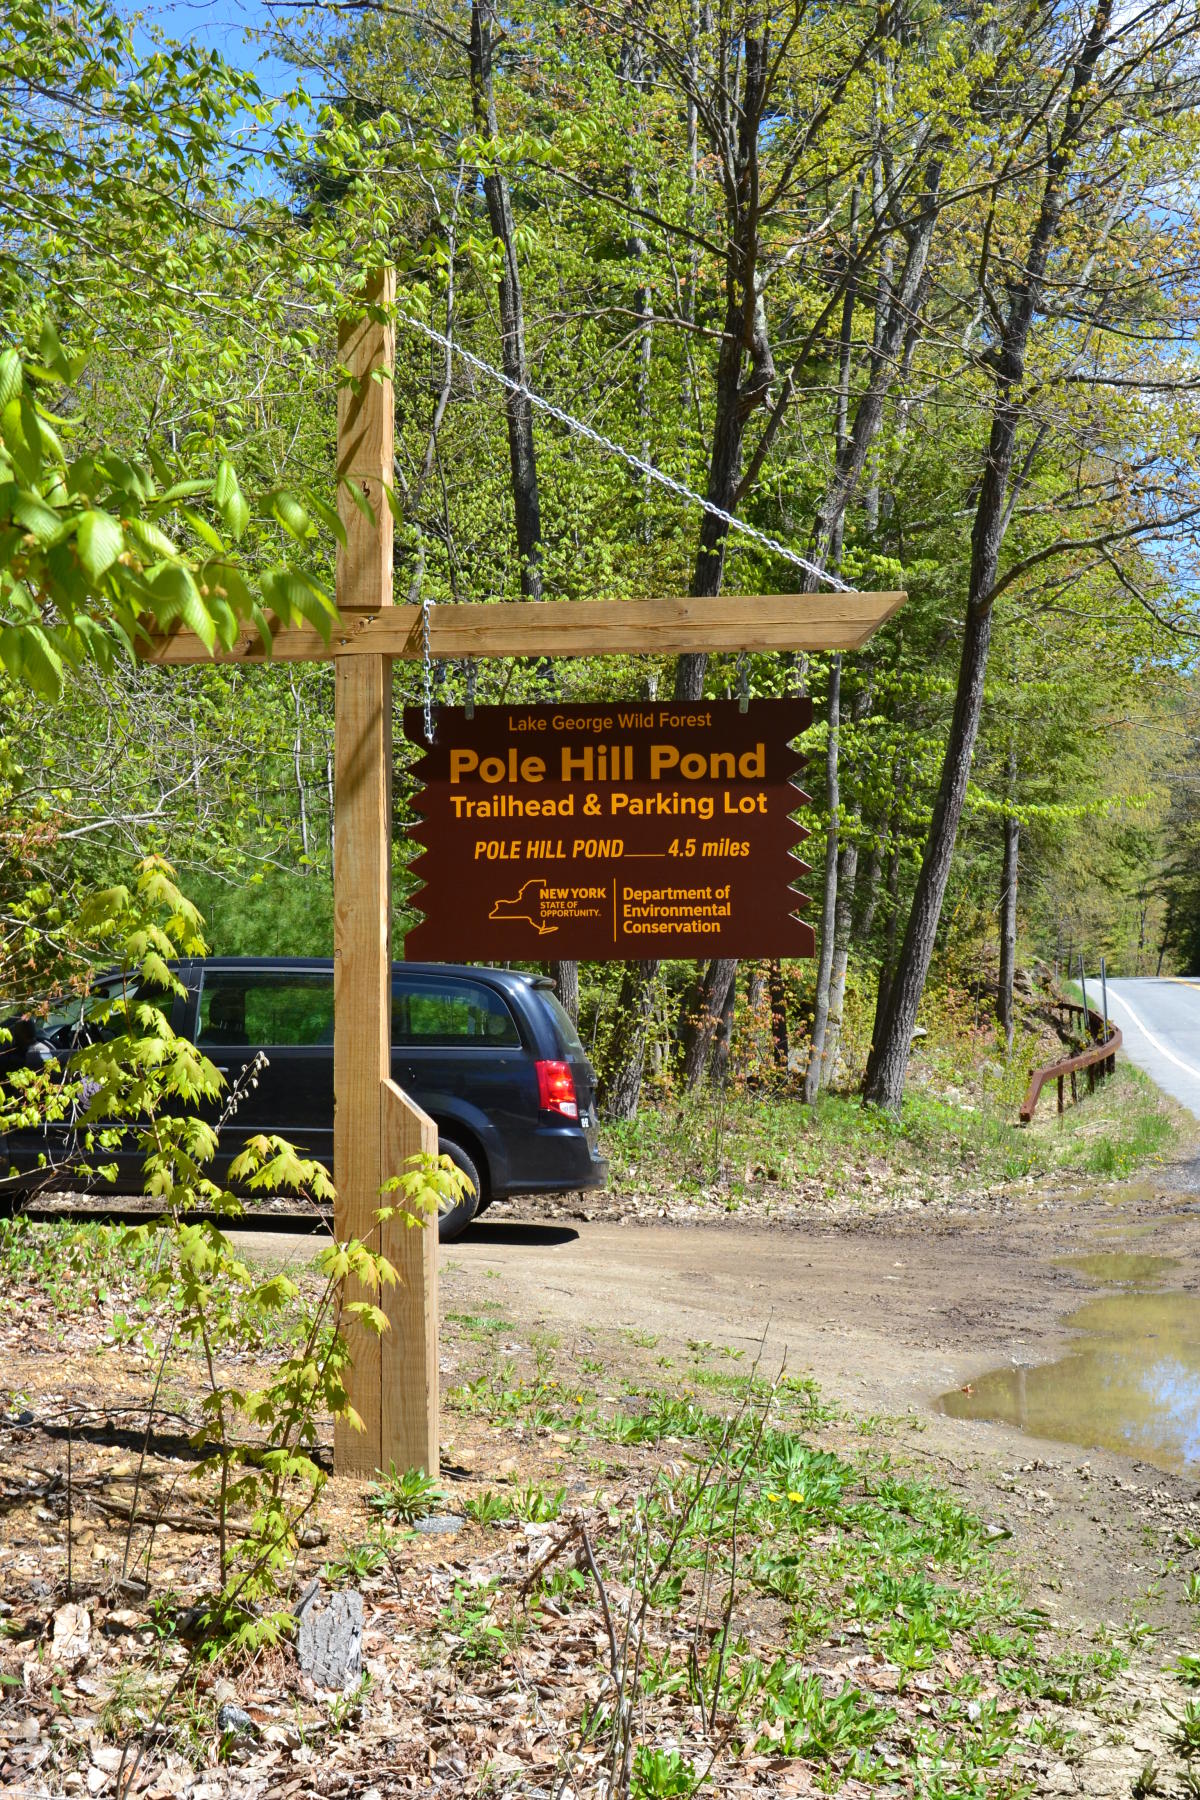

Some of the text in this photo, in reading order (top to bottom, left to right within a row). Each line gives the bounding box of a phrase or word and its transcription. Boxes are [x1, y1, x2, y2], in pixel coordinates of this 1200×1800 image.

[509, 712, 711, 733] Lake George Wild Forest
[450, 742, 766, 784] Pole Hill Pond
[450, 791, 768, 820] Trailhead & Parking Lot
[475, 837, 750, 860] POLE HILL POND 4.5 miles
[539, 887, 606, 899] NEW YORK
[623, 885, 730, 902] Department of
[540, 901, 578, 909] STATE OF
[623, 900, 731, 917] Environmental
[623, 919, 721, 934] Conservation
